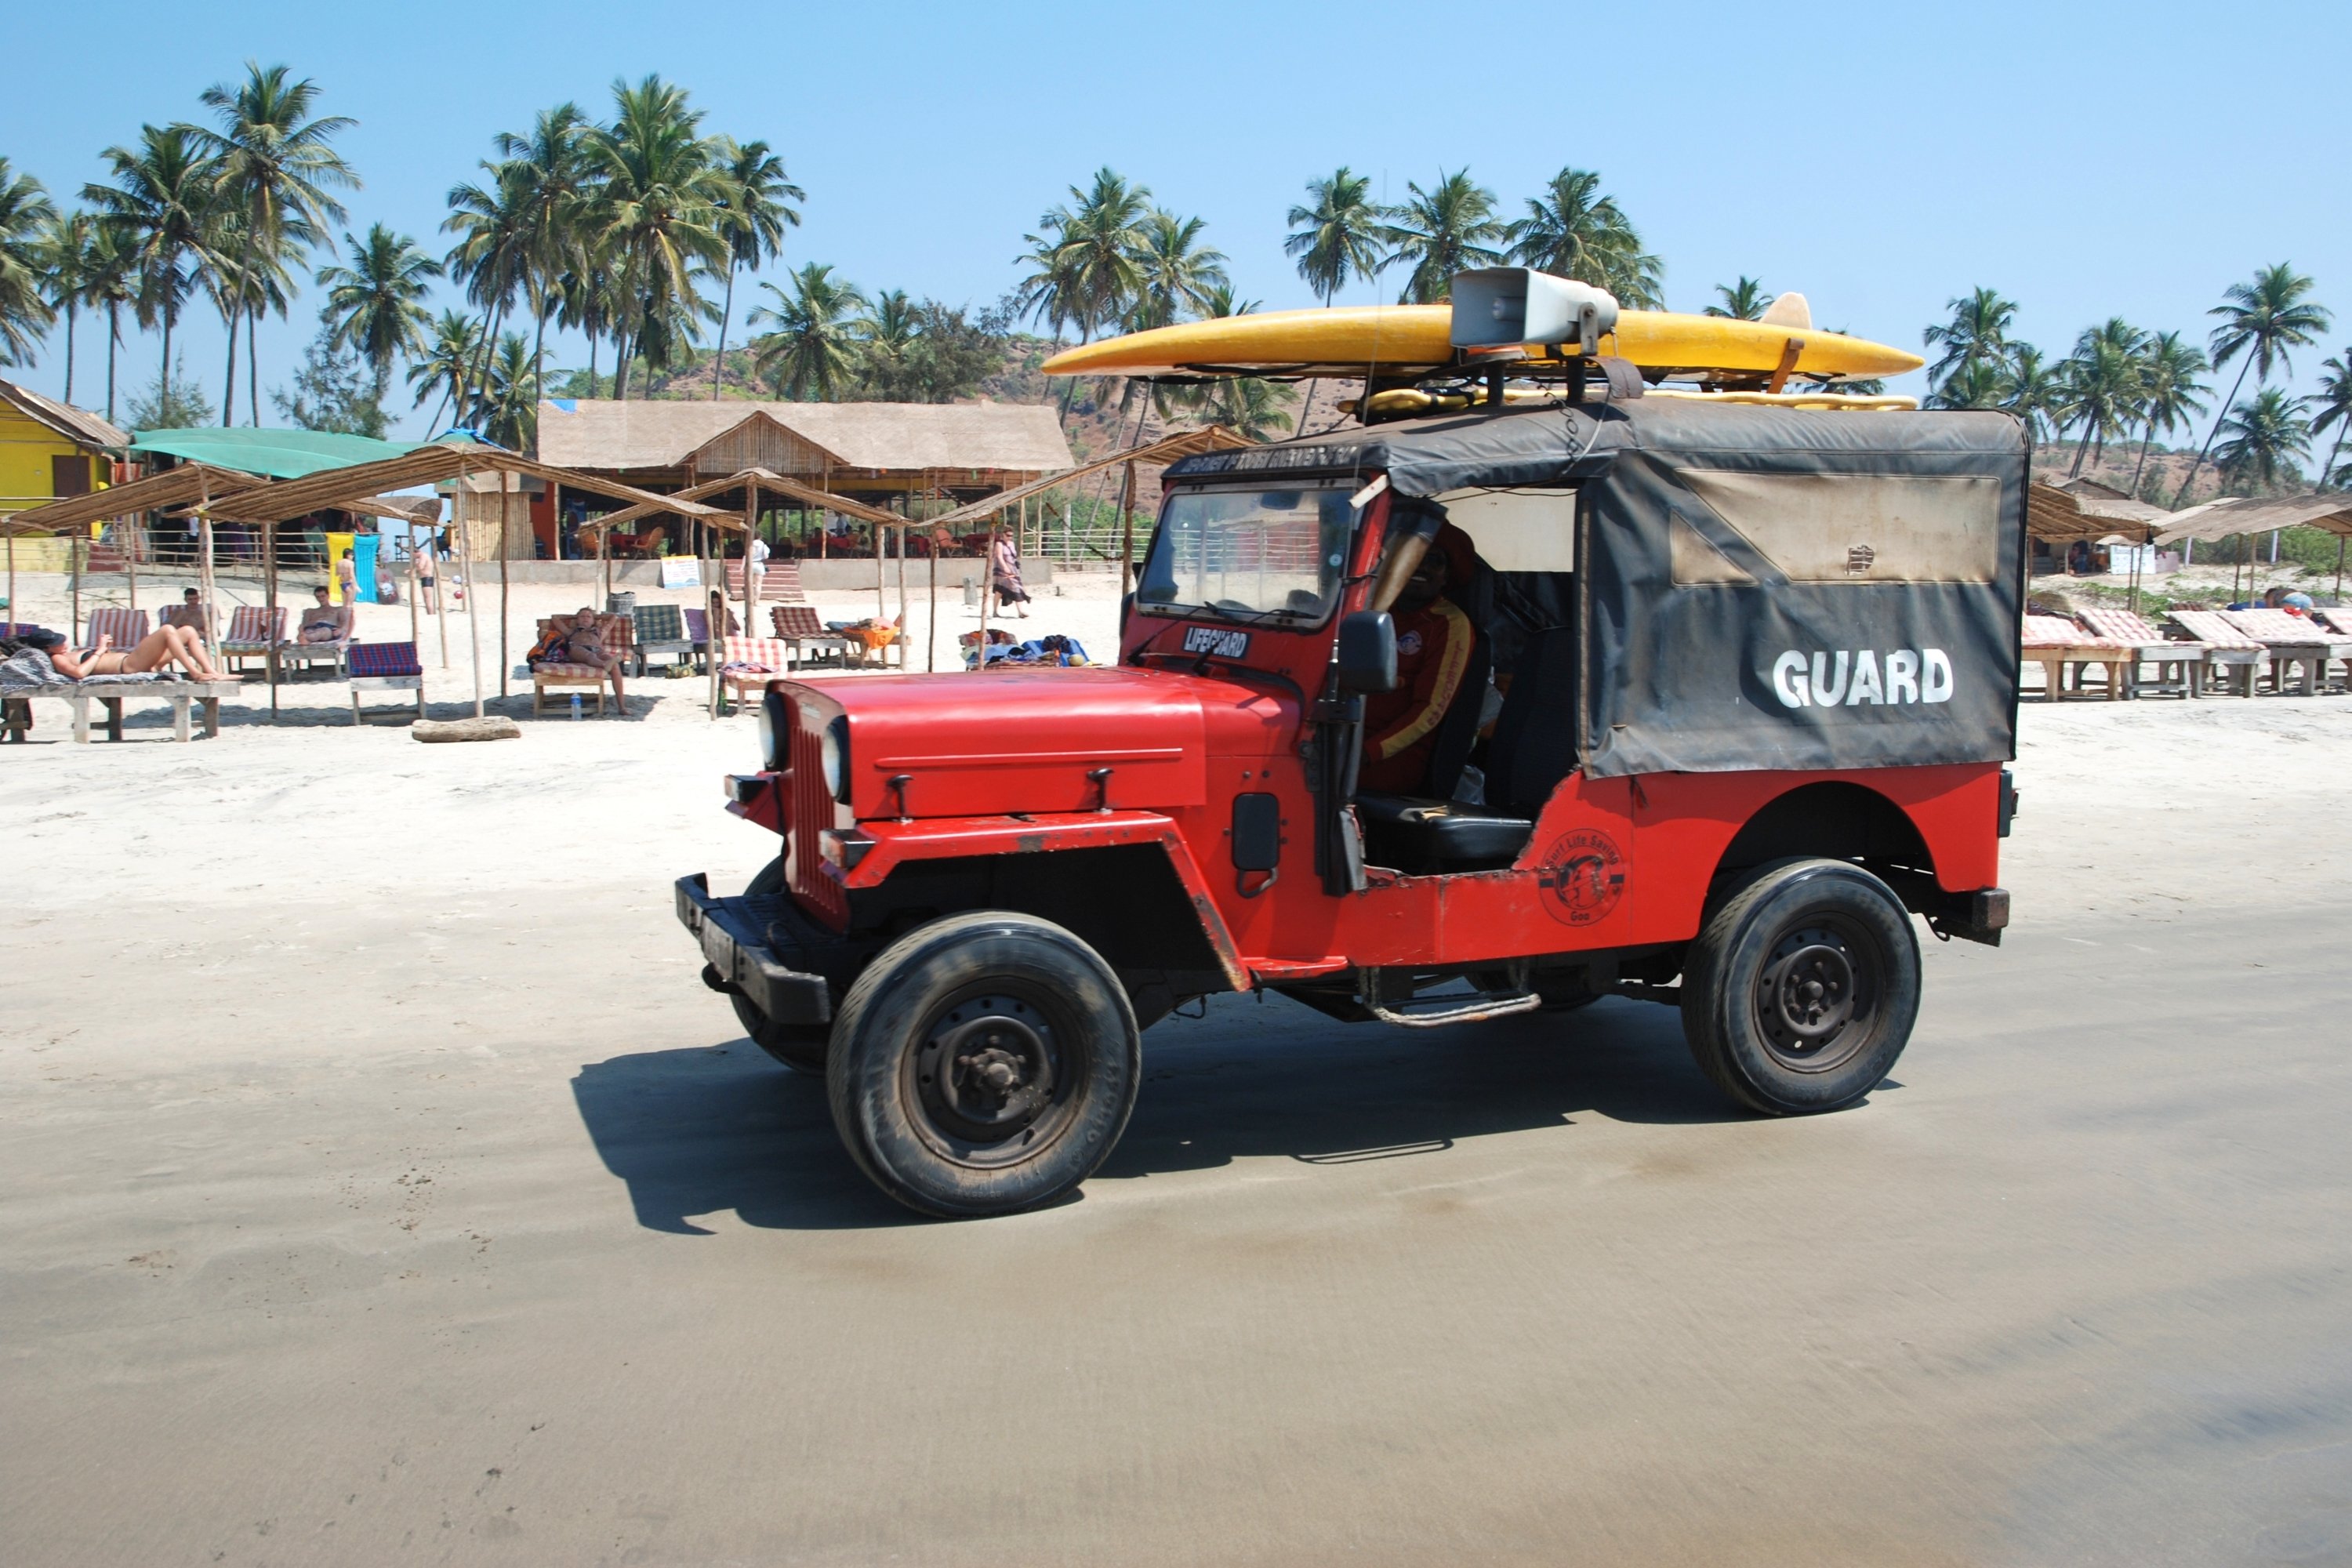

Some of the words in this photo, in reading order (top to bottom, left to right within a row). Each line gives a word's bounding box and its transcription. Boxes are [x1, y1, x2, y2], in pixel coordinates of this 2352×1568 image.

[1184, 626, 1247, 658] LIFEGUARD
[1773, 648, 1954, 709] GUARD
[1544, 843, 1565, 868] Surf
[1566, 835, 1588, 848] Life
[1590, 835, 1619, 866] Saving
[1570, 911, 1590, 921] Goa
